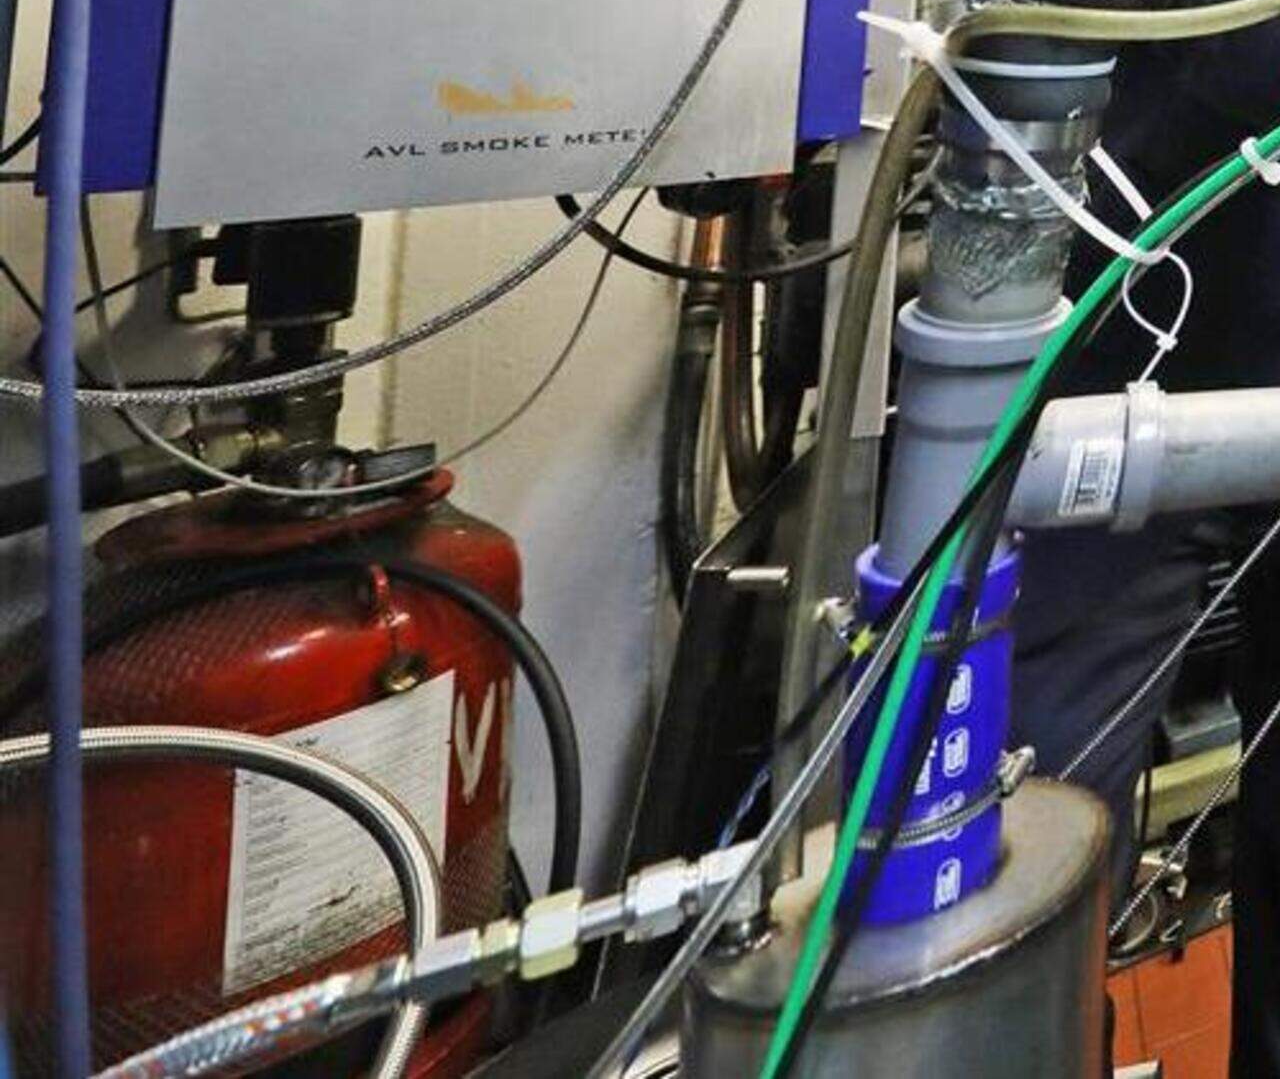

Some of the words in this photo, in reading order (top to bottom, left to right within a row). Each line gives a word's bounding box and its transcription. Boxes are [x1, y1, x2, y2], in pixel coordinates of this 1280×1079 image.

[364, 144, 426, 159] AVL
[440, 135, 550, 155] SMOKE
[564, 128, 647, 146] METE
